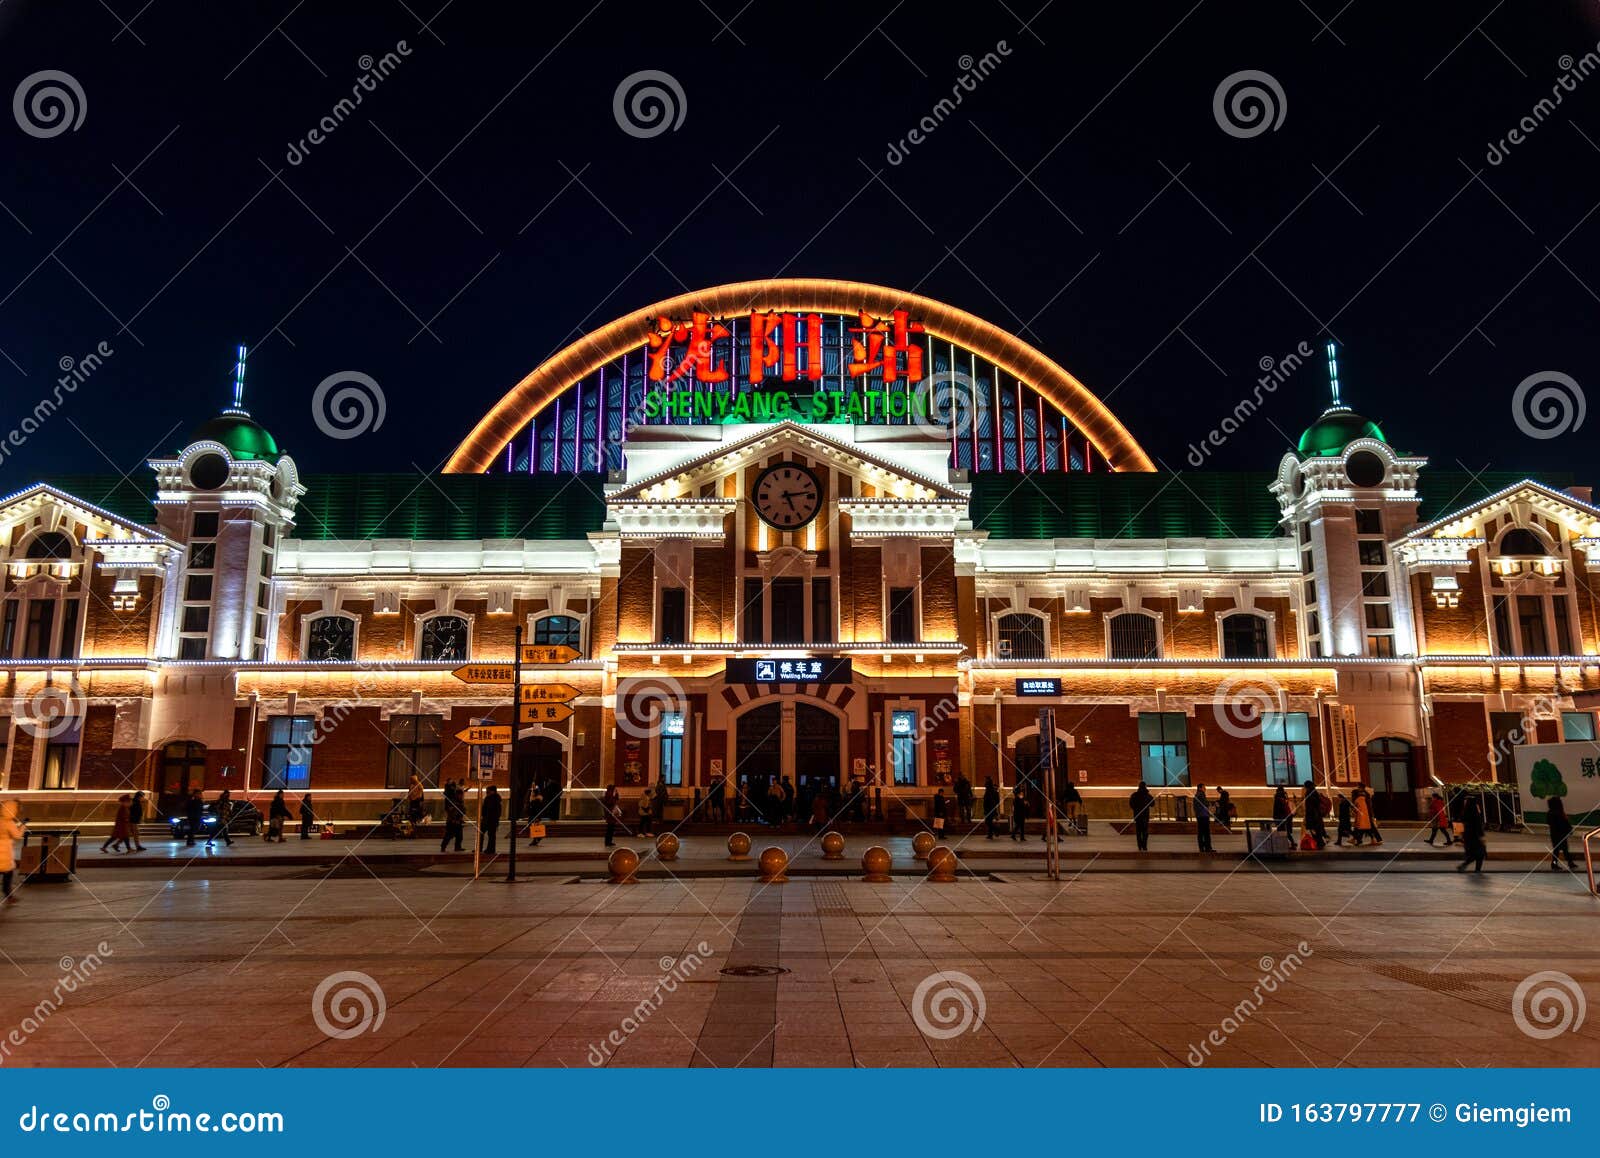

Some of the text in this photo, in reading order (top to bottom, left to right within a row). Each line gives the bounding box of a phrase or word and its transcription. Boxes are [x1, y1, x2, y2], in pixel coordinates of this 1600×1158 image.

[648, 309, 925, 383] 沈阳站
[645, 391, 927, 417] SHENYANG STATION
[780, 662, 822, 673] 候车室
[528, 707, 557, 718] 地铁
